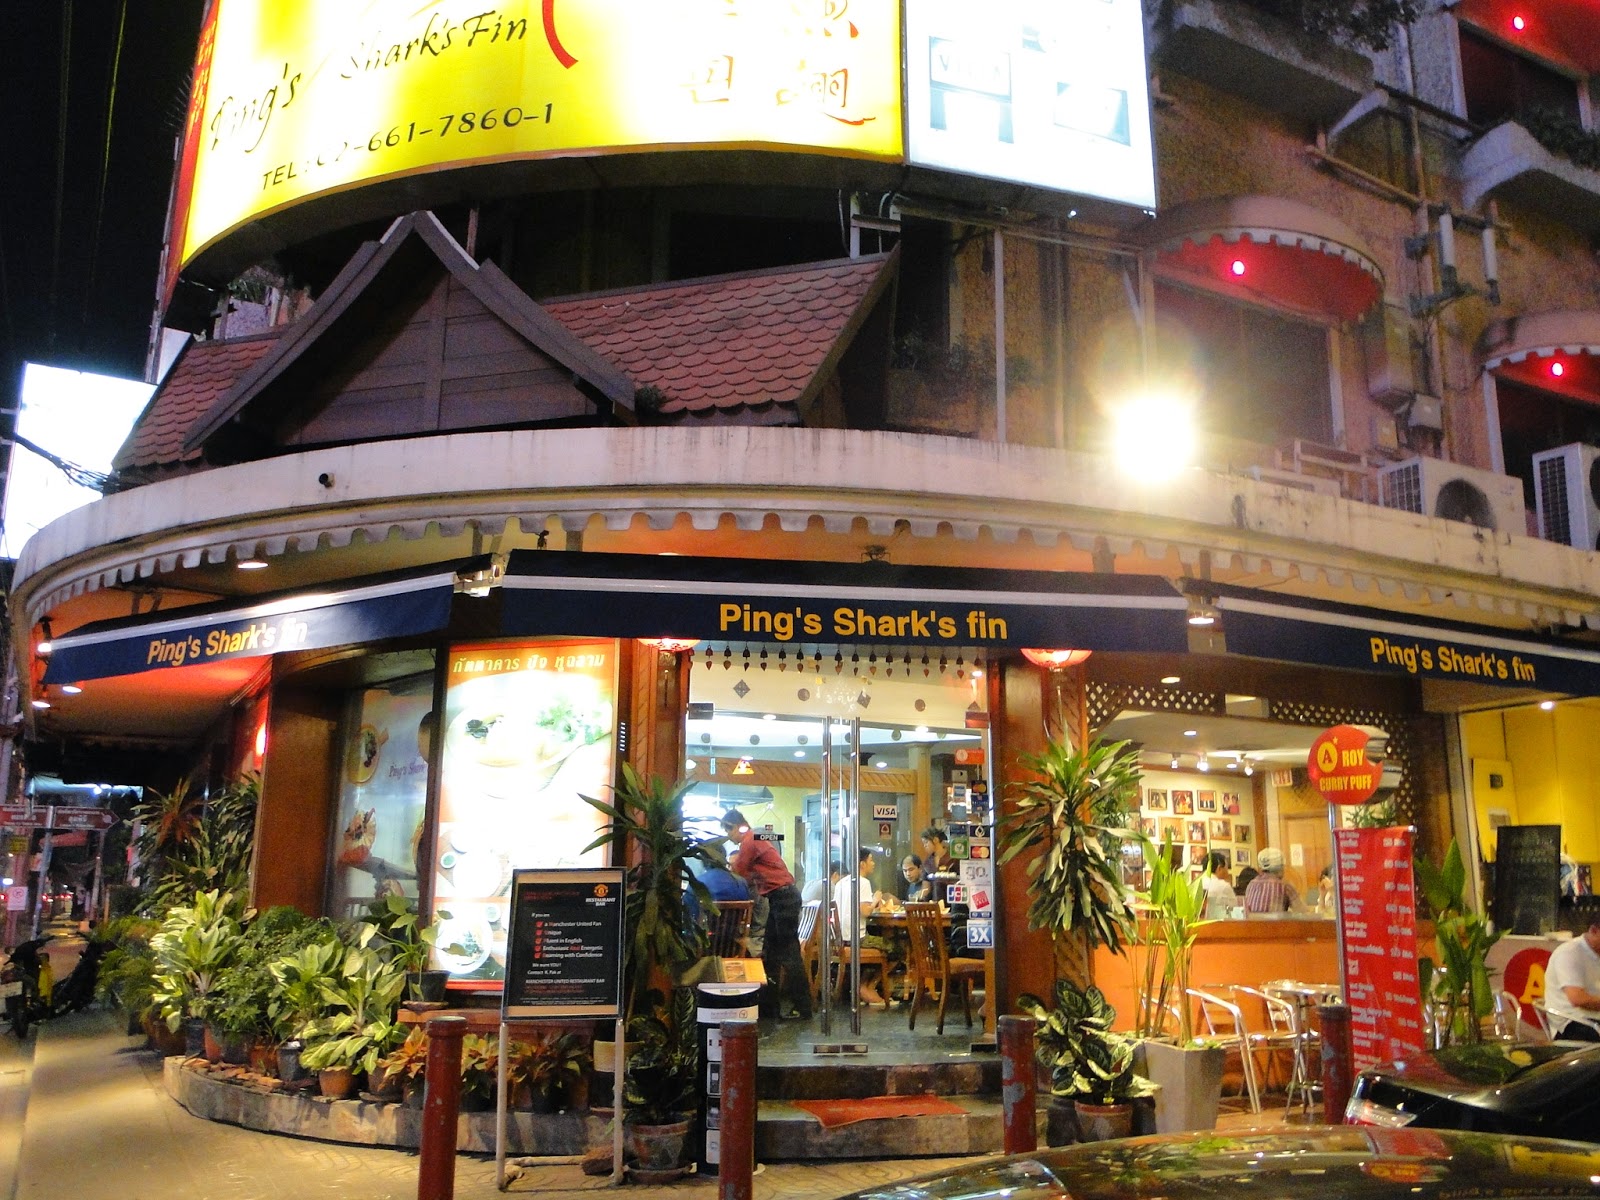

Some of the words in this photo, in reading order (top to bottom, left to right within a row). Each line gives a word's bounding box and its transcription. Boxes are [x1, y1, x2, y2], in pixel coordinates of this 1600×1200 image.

[463, 10, 528, 47] Fin
[720, 603, 823, 641] Ping's
[833, 607, 957, 639] Shark's
[966, 610, 1008, 640] fin
[146, 635, 201, 667] Ping's
[206, 622, 277, 656] Shark's
[279, 617, 308, 648] fin
[1369, 637, 1433, 674] Ping's
[1438, 646, 1508, 680] Shark's
[1512, 655, 1536, 682] fin
[1342, 749, 1364, 767] ROY
[1319, 776, 1348, 792] CURRY
[1350, 775, 1372, 790] PUFF
[876, 807, 897, 816] VISA
[970, 926, 990, 943] 3X
